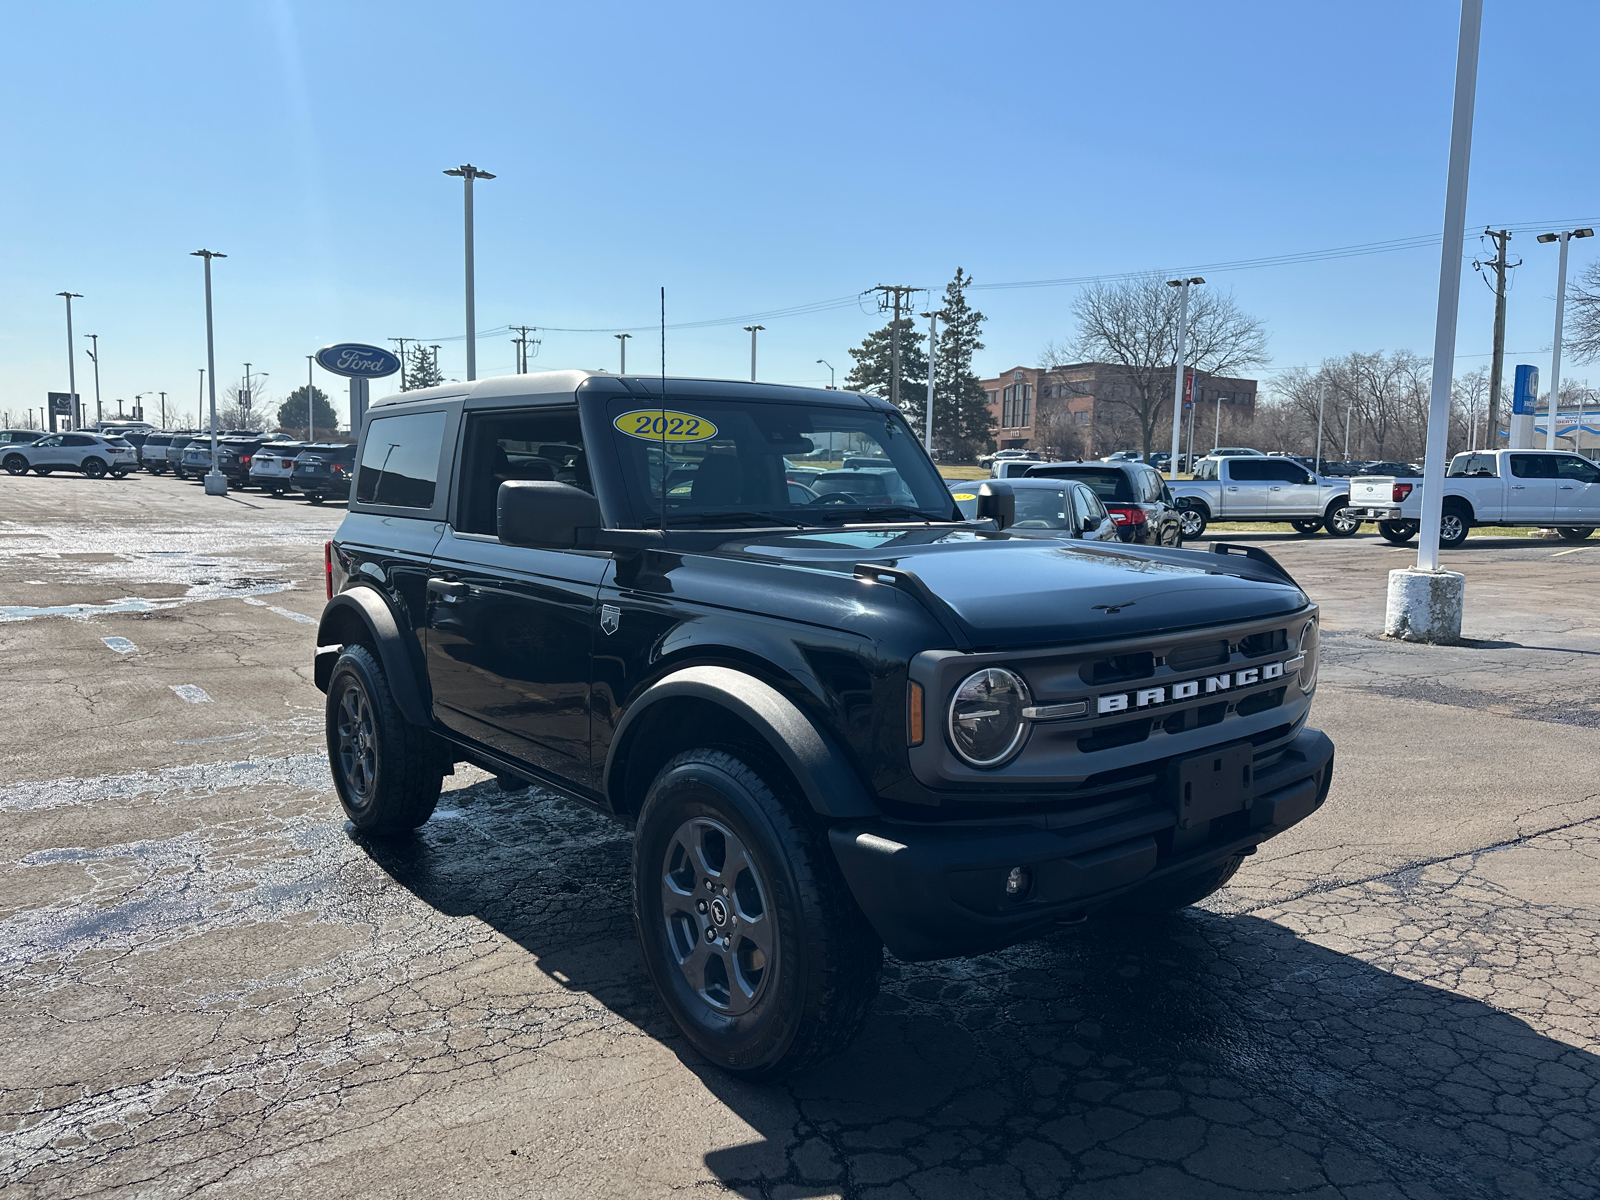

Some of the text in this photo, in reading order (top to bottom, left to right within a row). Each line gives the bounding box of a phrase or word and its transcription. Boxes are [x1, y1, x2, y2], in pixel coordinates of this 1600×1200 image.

[337, 349, 385, 371] Ford
[634, 416, 700, 436] 2022
[1098, 662, 1283, 713] BRONCO
